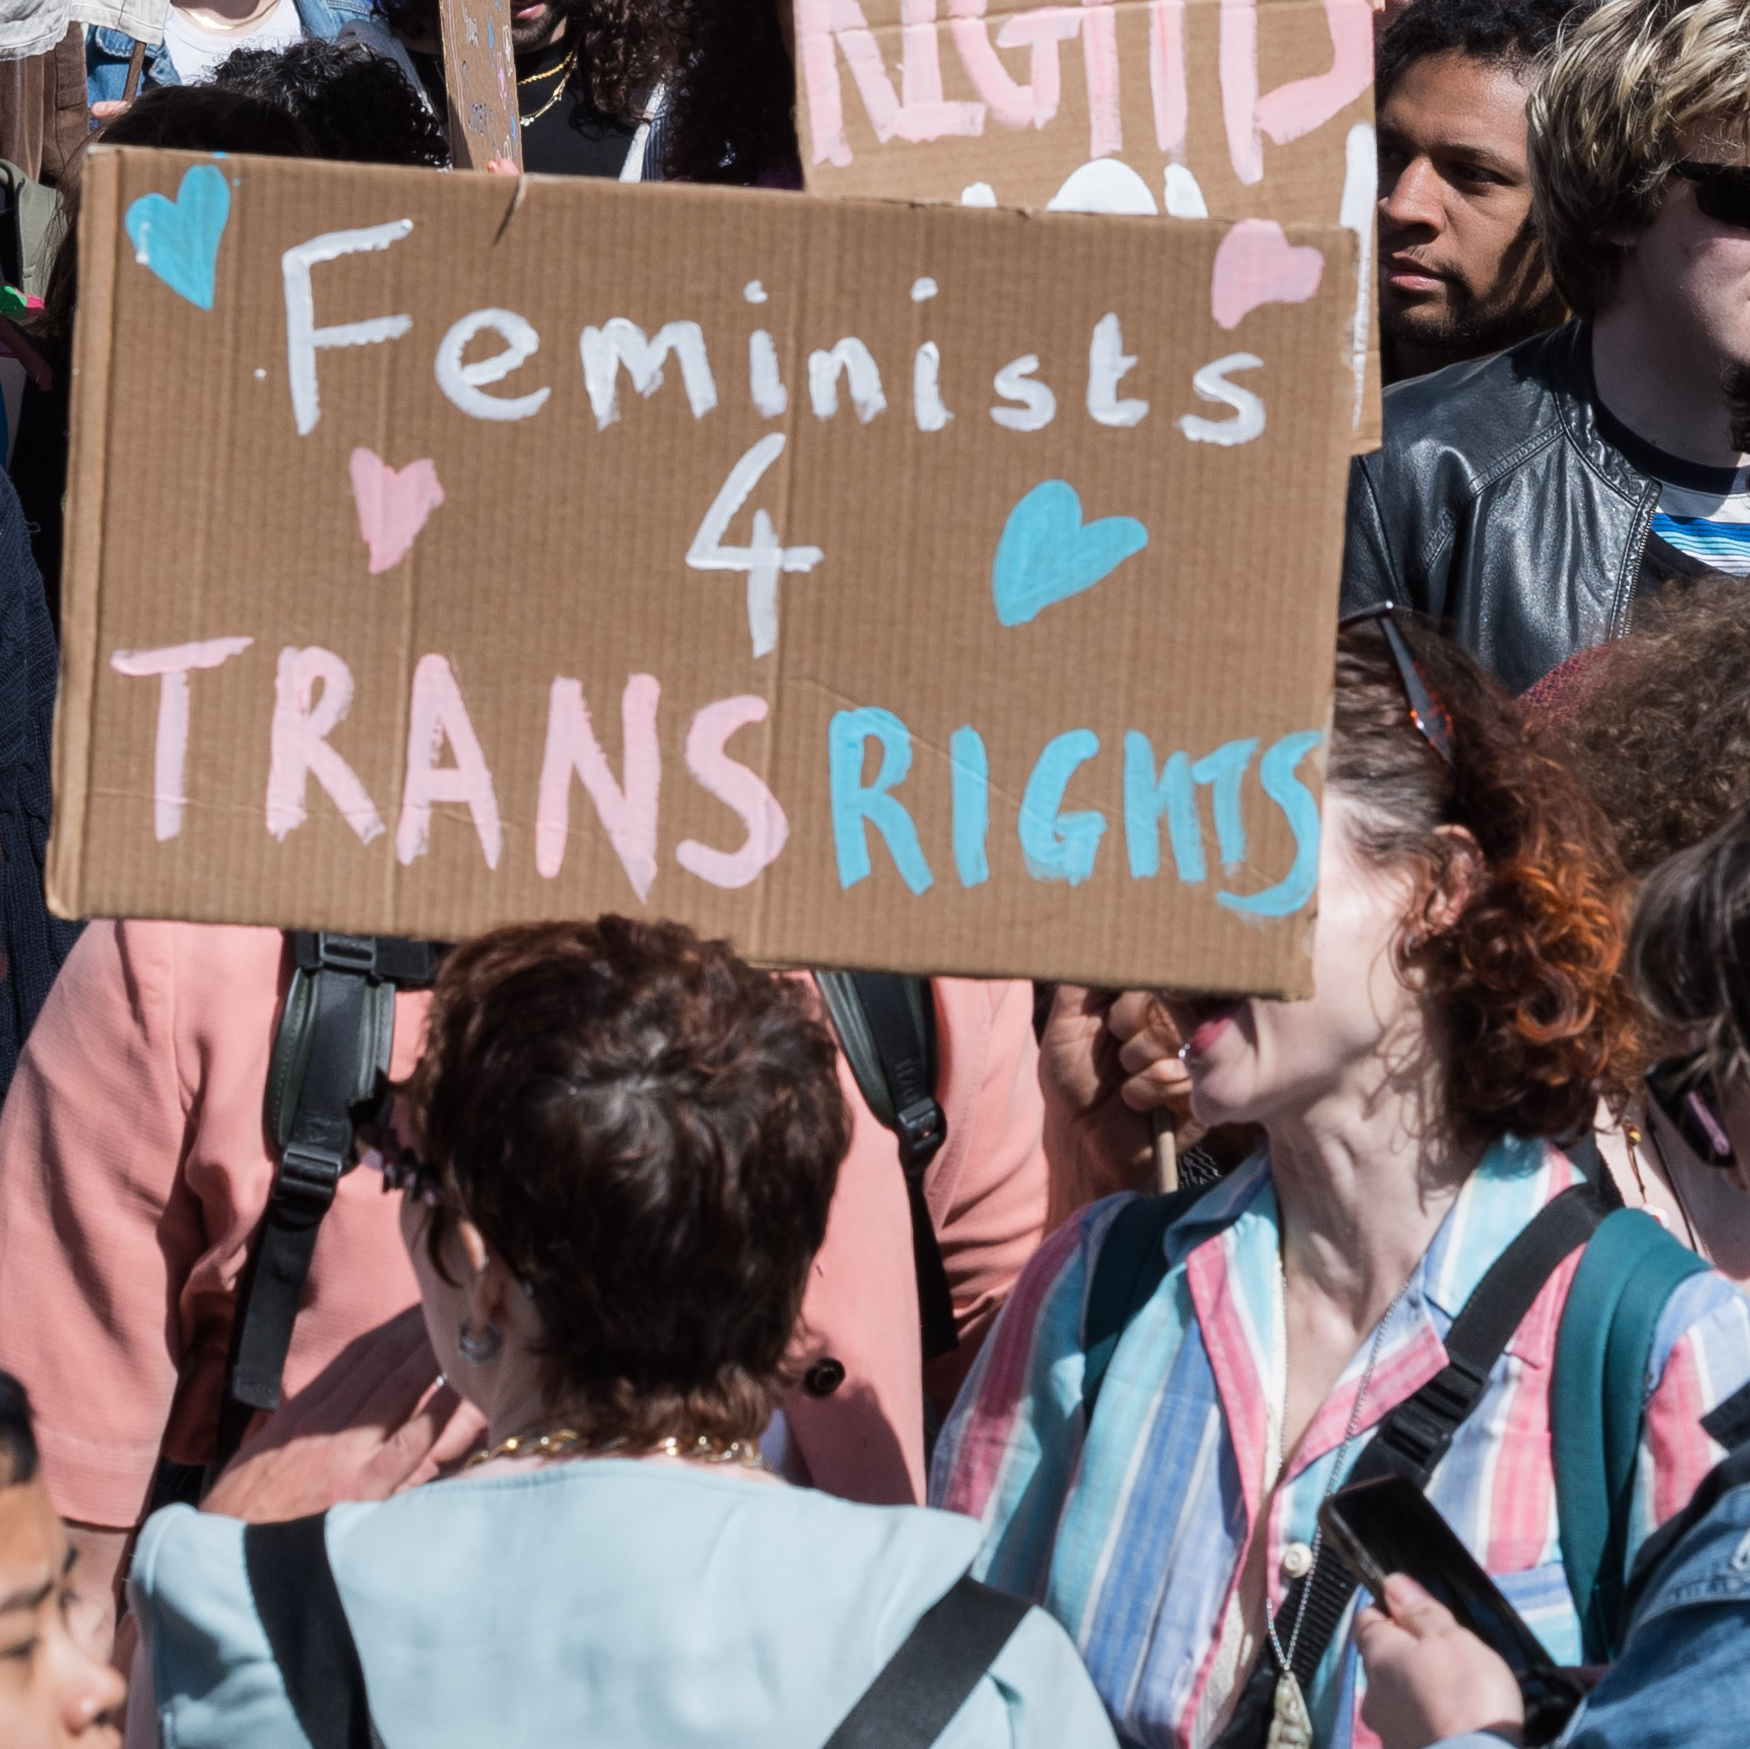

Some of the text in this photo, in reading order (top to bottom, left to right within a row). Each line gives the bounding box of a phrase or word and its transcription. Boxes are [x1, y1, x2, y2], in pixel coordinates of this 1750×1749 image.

[282, 217, 1269, 446] Feminists
[683, 430, 825, 659] 4
[109, 635, 1326, 920] TRANS RIGHTS
